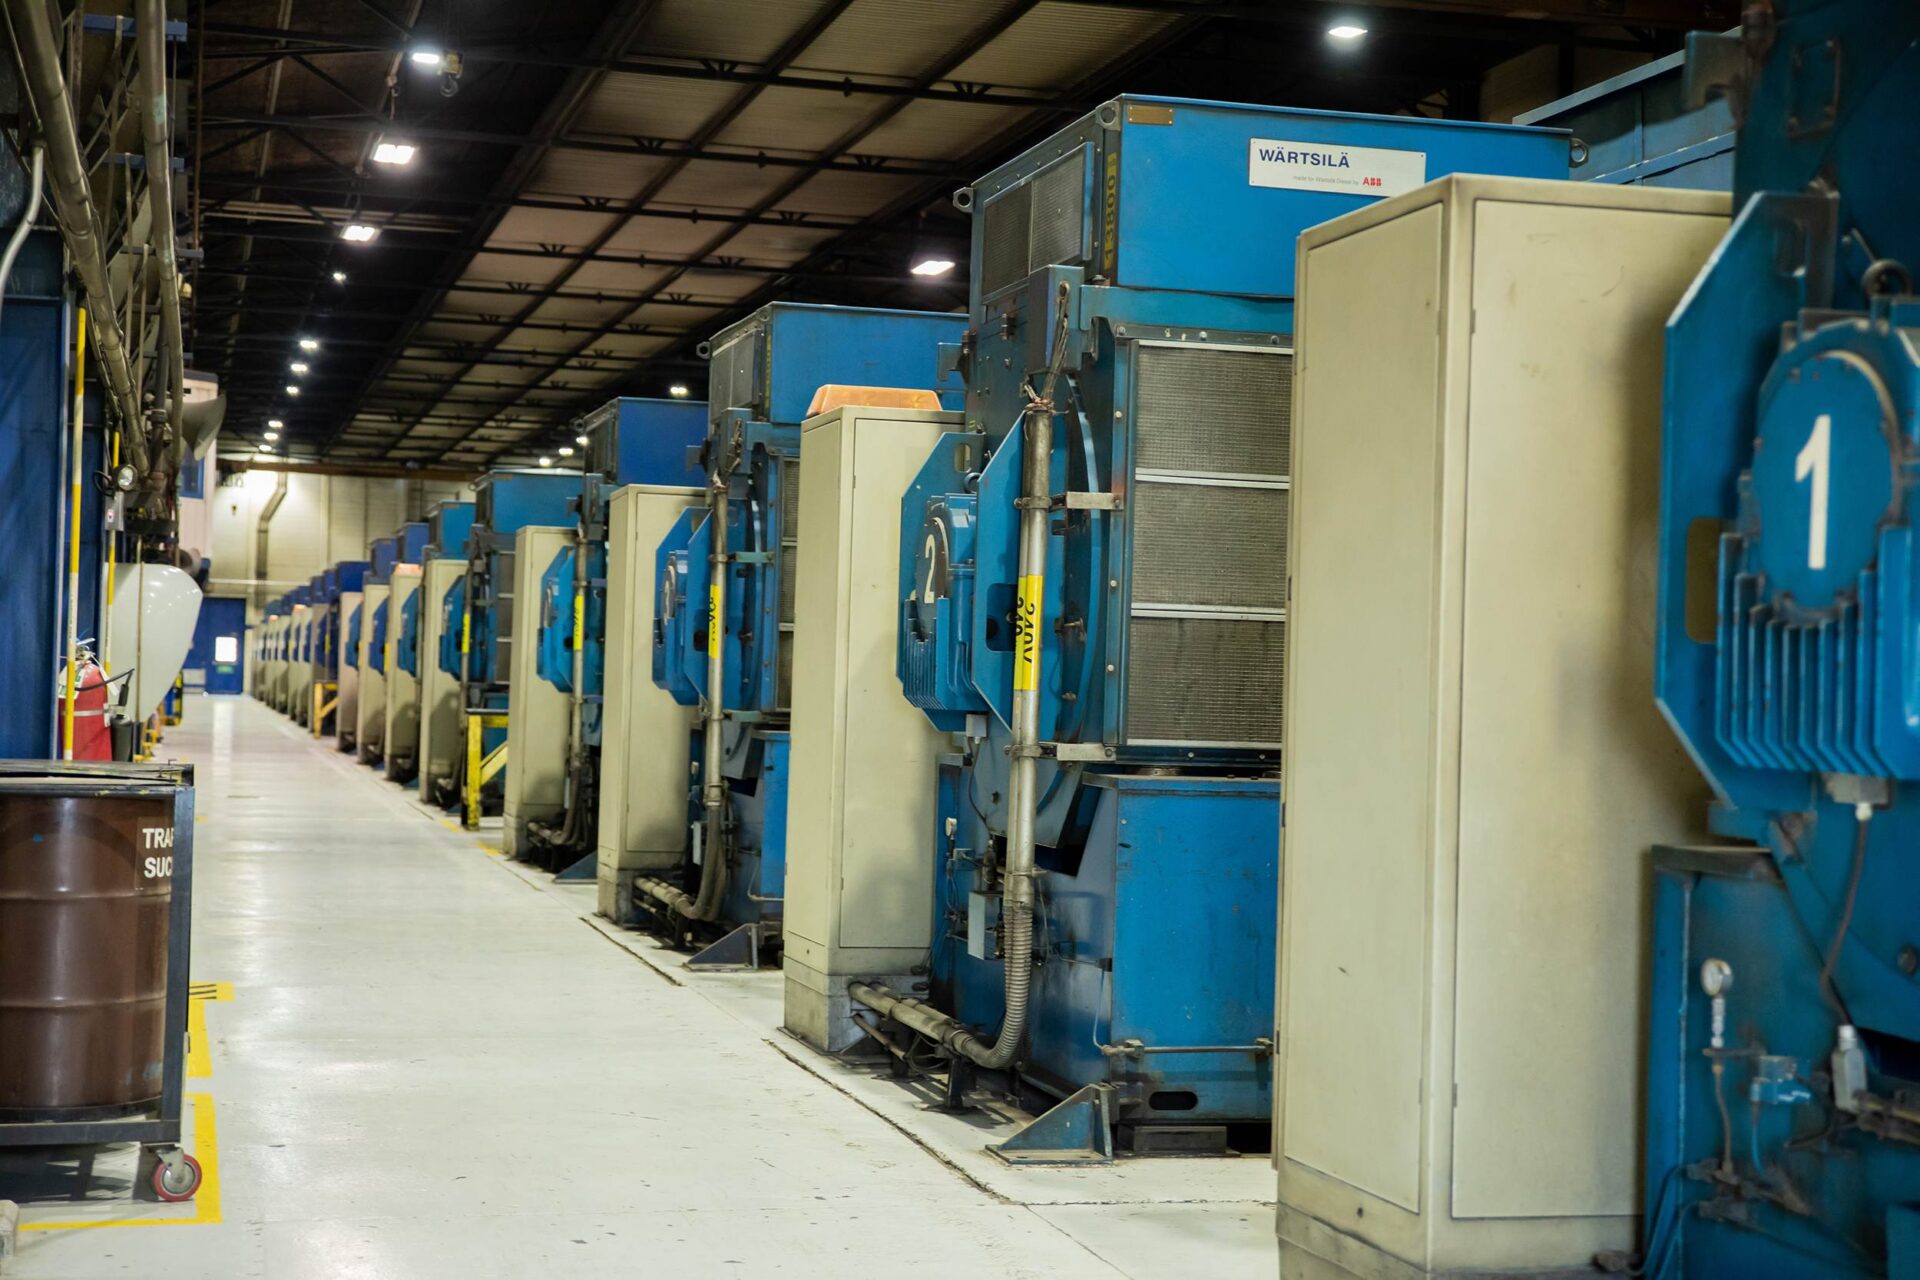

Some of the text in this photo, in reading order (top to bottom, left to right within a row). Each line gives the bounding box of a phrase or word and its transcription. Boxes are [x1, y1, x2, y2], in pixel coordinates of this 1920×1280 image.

[1259, 146, 1350, 169] WÄRTSILÄ
[1362, 176, 1382, 187] ABB
[1794, 414, 1832, 570] 1
[924, 534, 935, 604] 2
